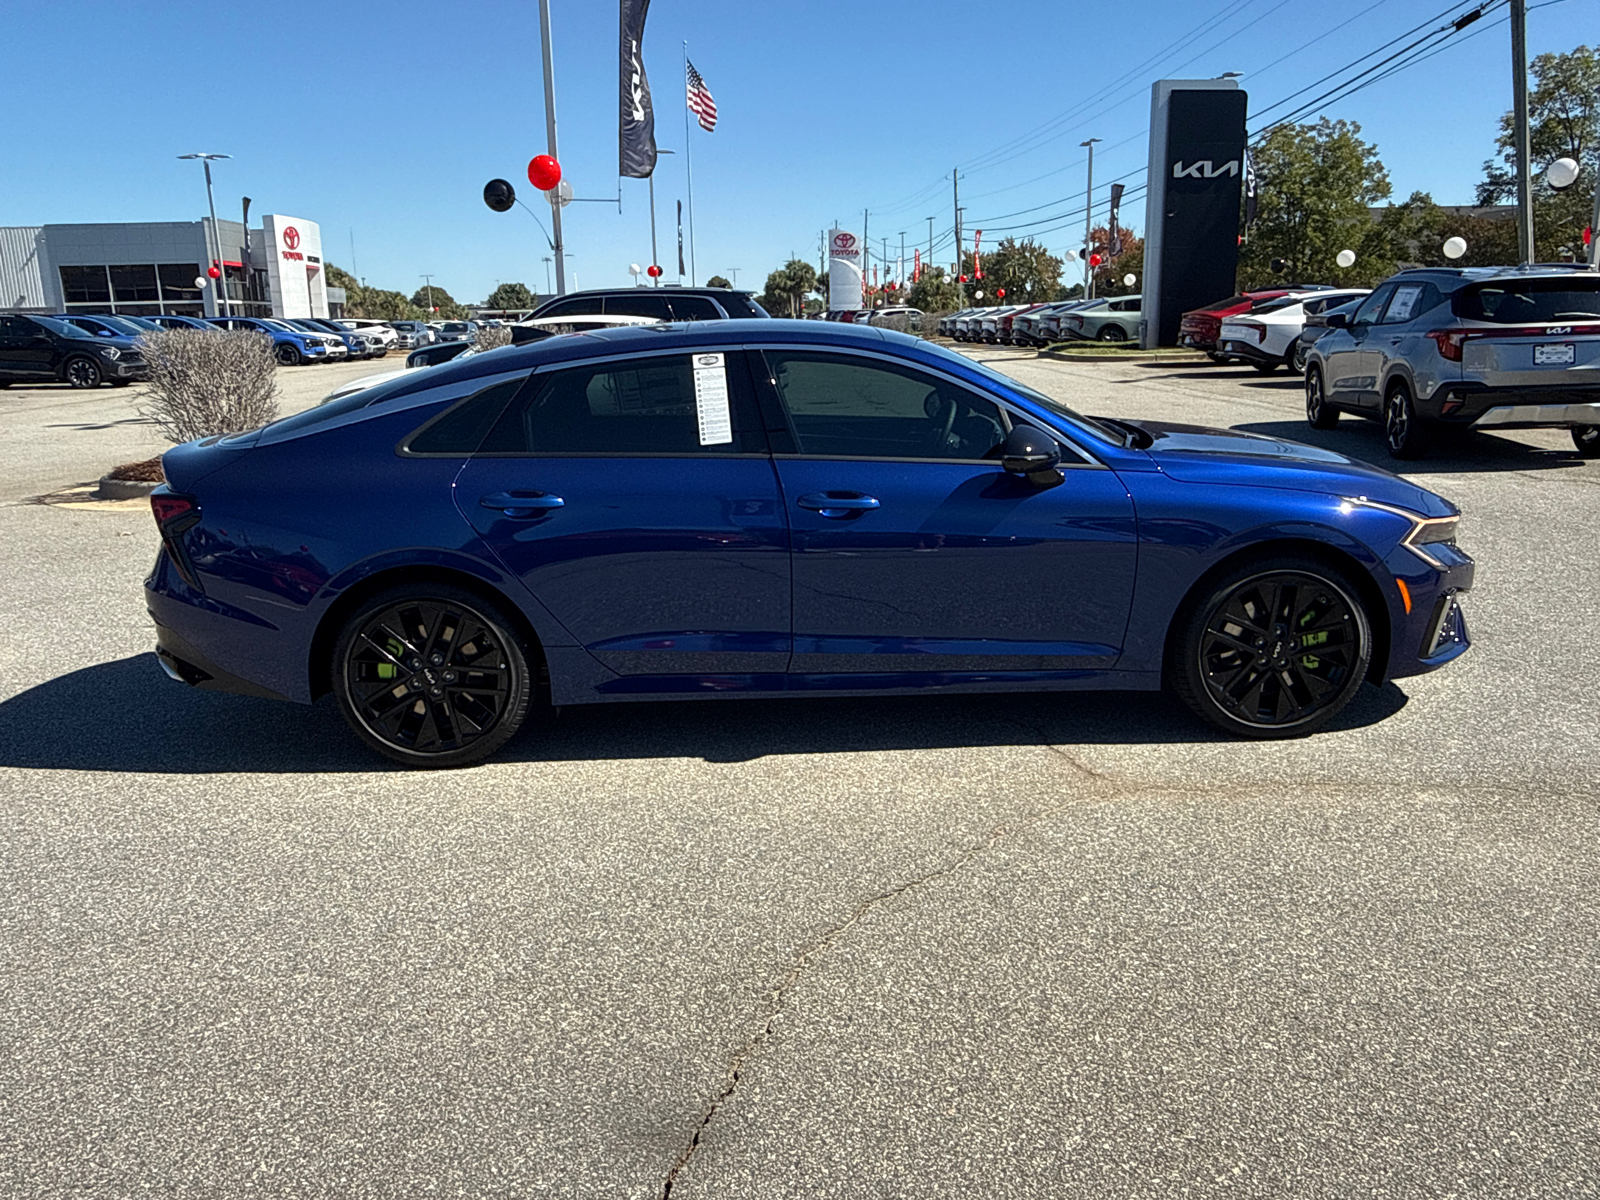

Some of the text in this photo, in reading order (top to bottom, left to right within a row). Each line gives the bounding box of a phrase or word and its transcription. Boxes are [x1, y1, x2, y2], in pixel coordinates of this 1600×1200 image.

[1173, 160, 1239, 178] KIA
[281, 250, 304, 261] TOYOTA
[1546, 326, 1572, 335] KIA
